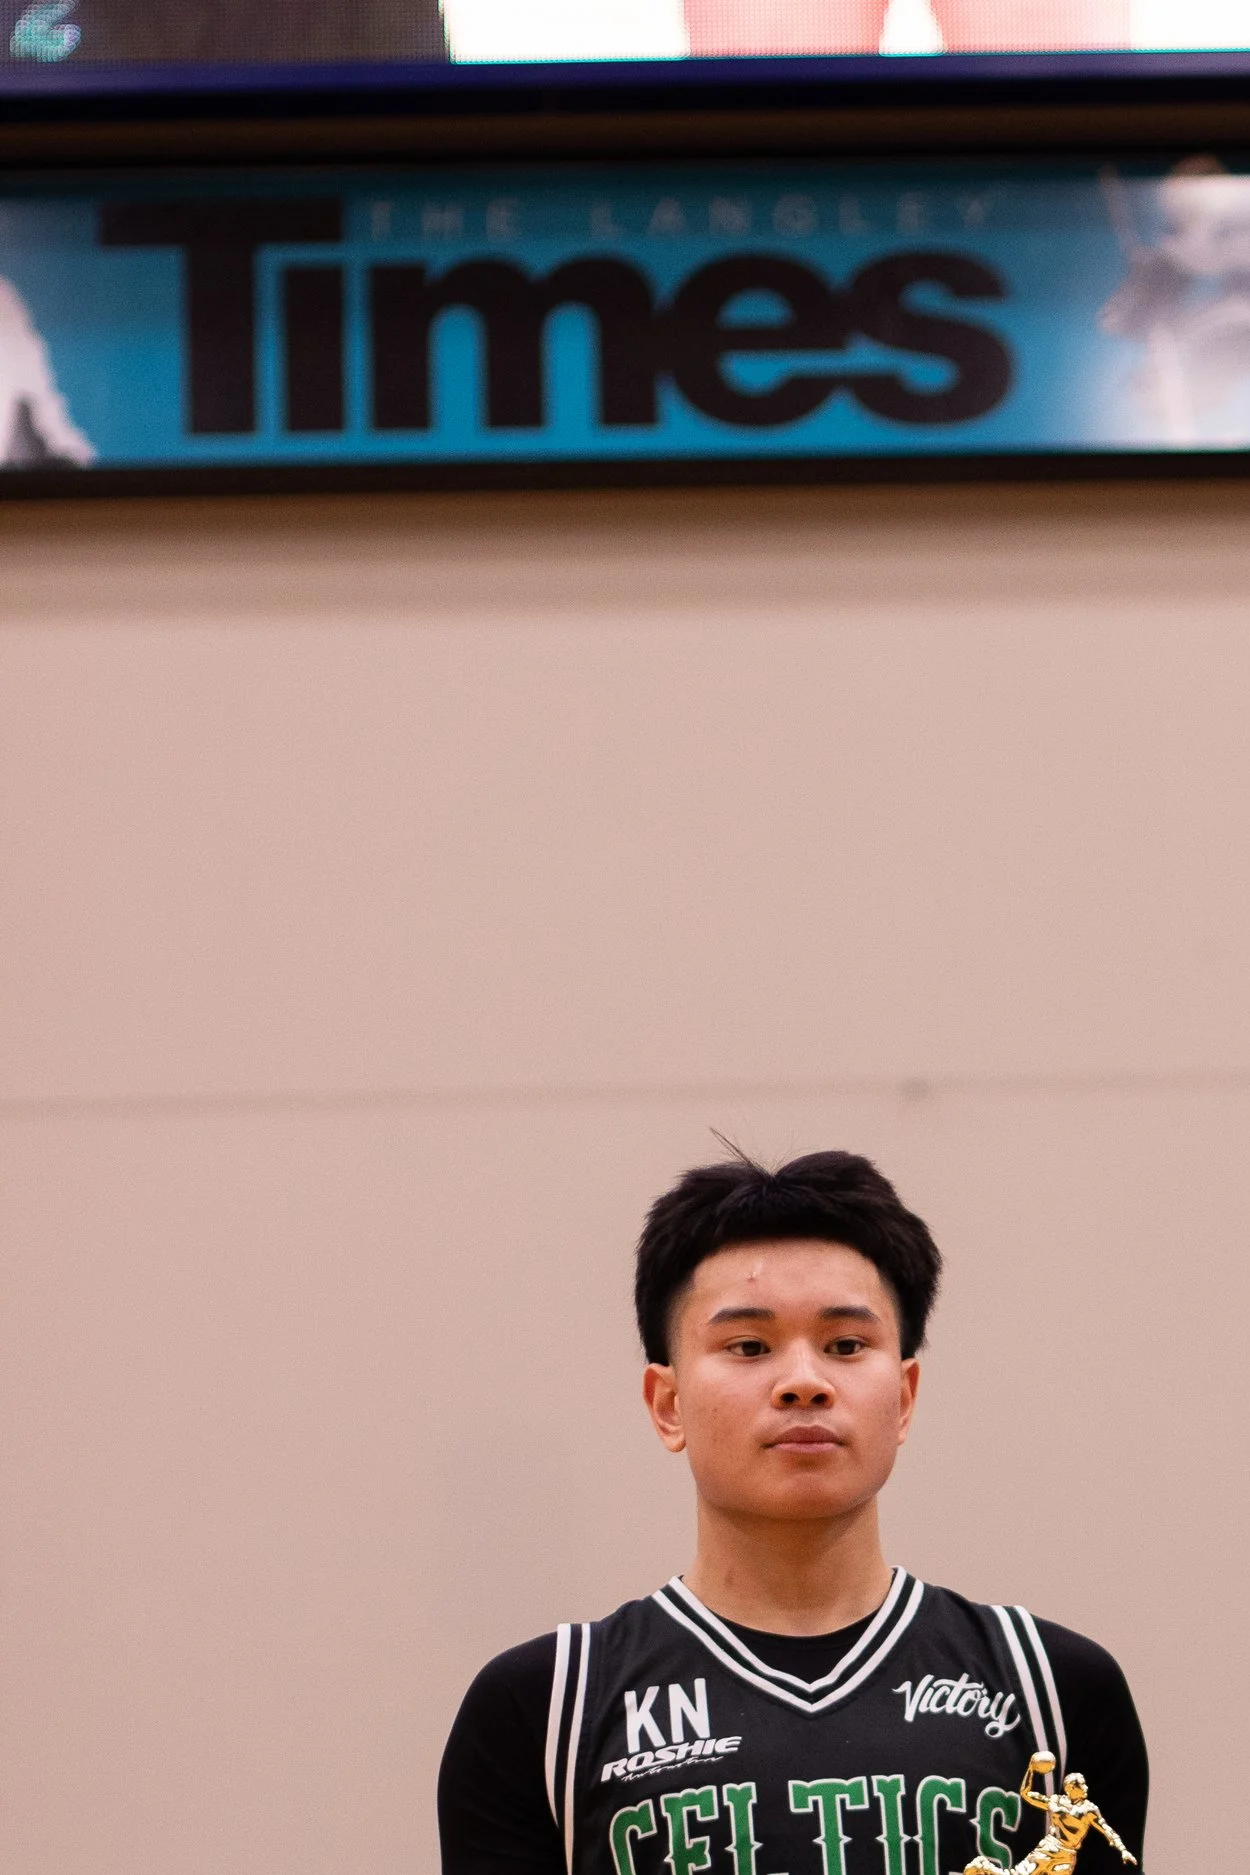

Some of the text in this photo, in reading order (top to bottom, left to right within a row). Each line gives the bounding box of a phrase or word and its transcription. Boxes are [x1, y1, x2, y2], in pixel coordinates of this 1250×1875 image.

[368, 190, 1000, 243] THE LANGLEY
[98, 194, 1018, 436] Times
[623, 1677, 711, 1754] KN
[891, 1672, 1021, 1738] Victory
[600, 1736, 743, 1782] ROSHIE
